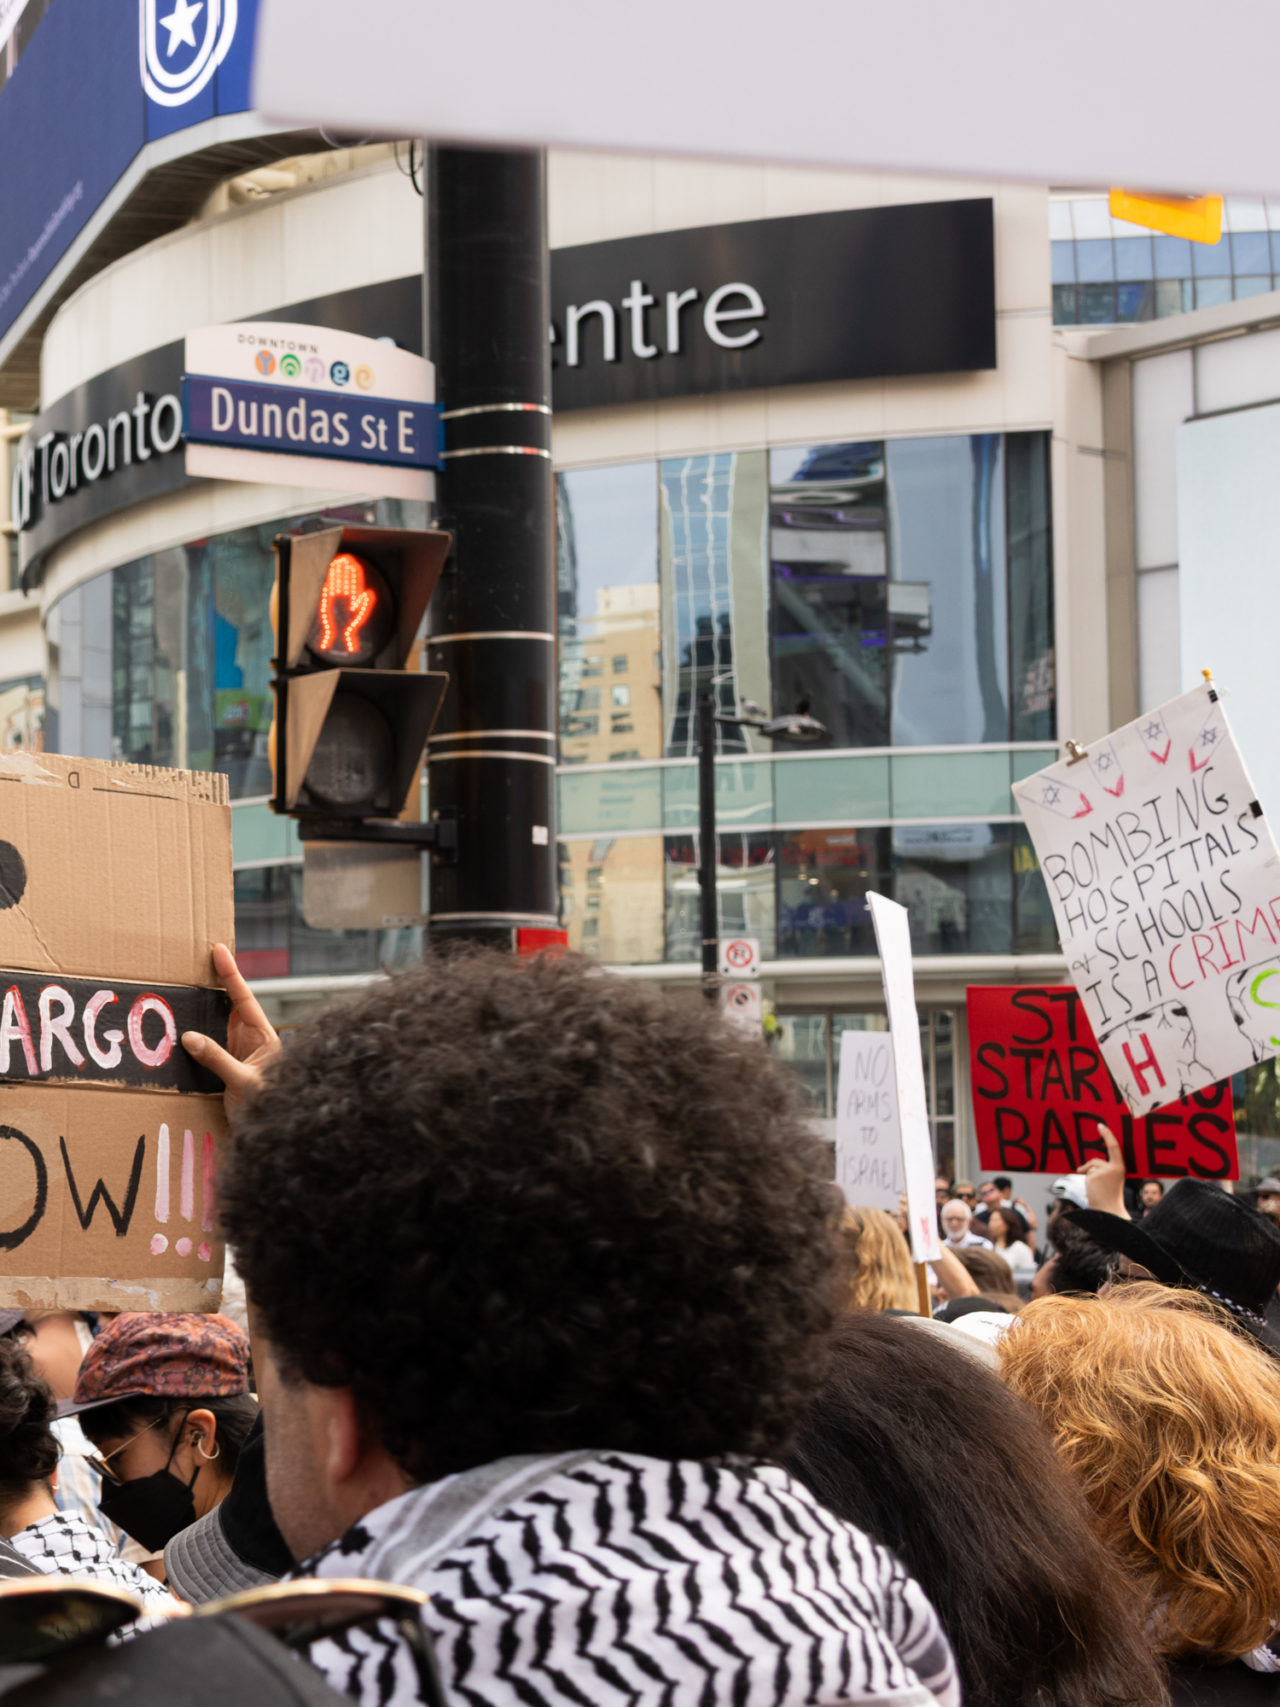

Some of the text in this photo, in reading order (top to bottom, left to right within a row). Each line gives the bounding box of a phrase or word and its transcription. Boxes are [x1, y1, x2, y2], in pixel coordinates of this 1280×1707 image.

[237, 333, 319, 354] DOWNTOWN
[549, 279, 767, 367] ntre
[38, 391, 182, 505] Toronto
[211, 387, 416, 454] Dundas St E
[1043, 766, 1230, 902] BOMBING
[1063, 812, 1259, 938] HOSPITALS
[1095, 869, 1243, 971] SCHOOLS
[1085, 972, 1134, 1026] IS
[1142, 959, 1162, 1003] A
[855, 1043, 890, 1088] NO
[1121, 1032, 1167, 1096] H
[847, 1088, 893, 1123] ARMS
[860, 1126, 878, 1146] TO
[842, 1153, 903, 1196] ISRAEL
[995, 1106, 1232, 1179] BABIES
